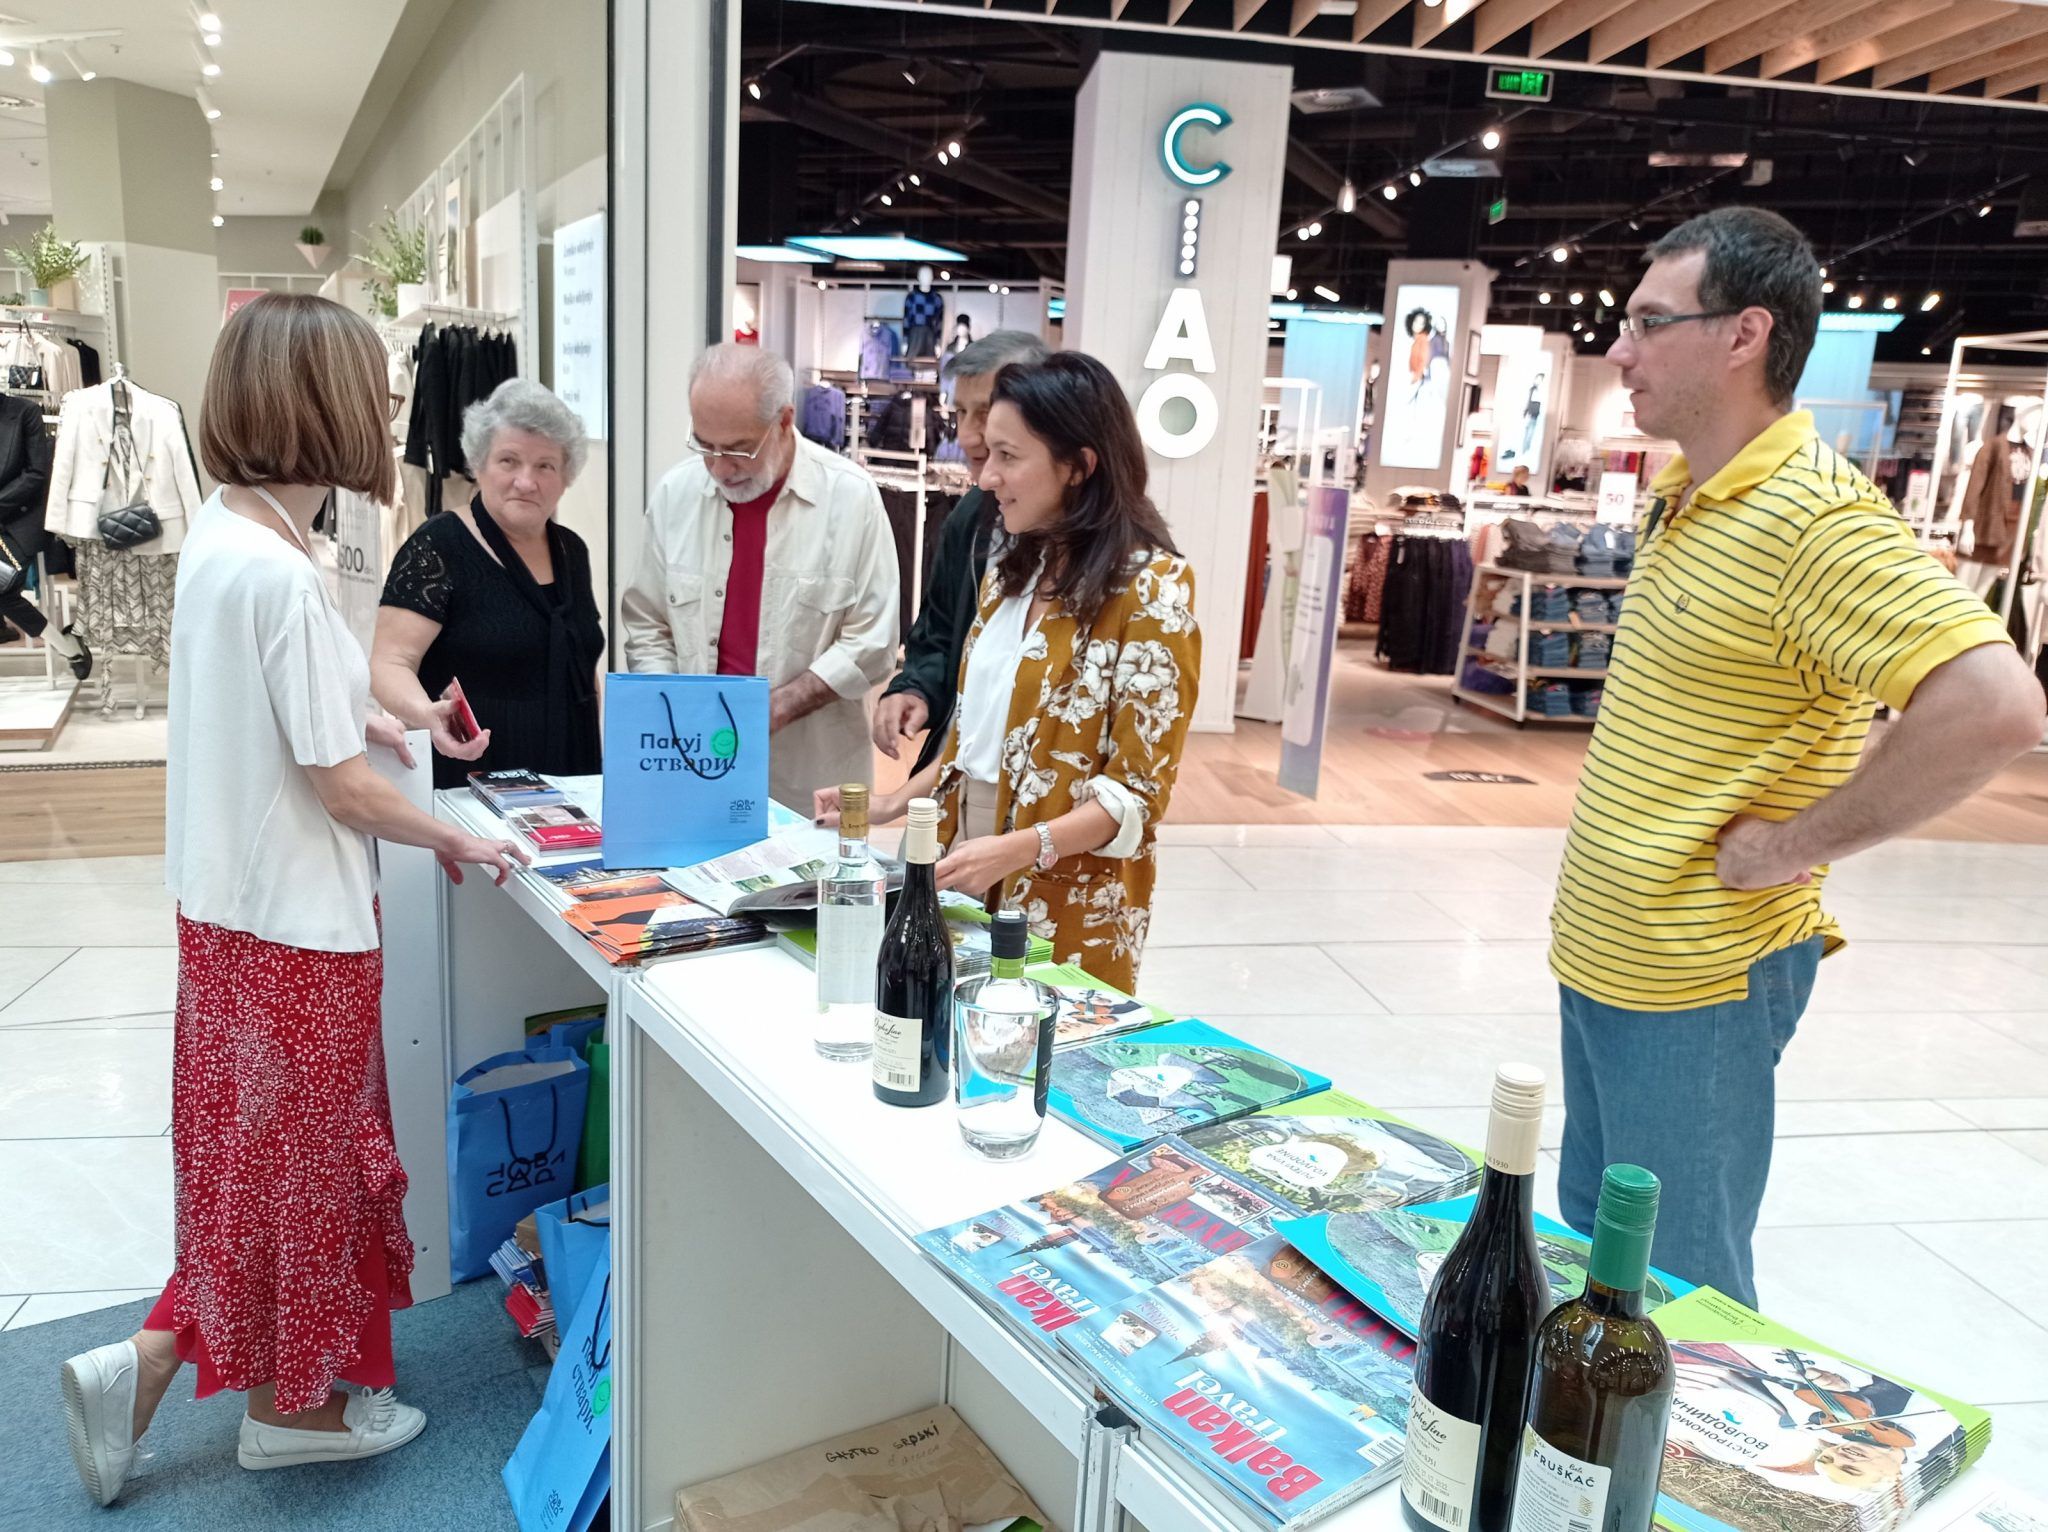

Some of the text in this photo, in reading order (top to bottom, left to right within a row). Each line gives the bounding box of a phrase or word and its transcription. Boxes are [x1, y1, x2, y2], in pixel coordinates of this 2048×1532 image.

[1137, 102, 1233, 458] CIAO
[1175, 1369, 1287, 1443] travel
[1669, 1411, 1758, 1459] ГАСТРОНОМС
[1672, 1397, 1769, 1450] ВОЈВОДИНА
[1163, 1388, 1324, 1502] Balkan
[1533, 1449, 1596, 1488] FRUŠKAČ
